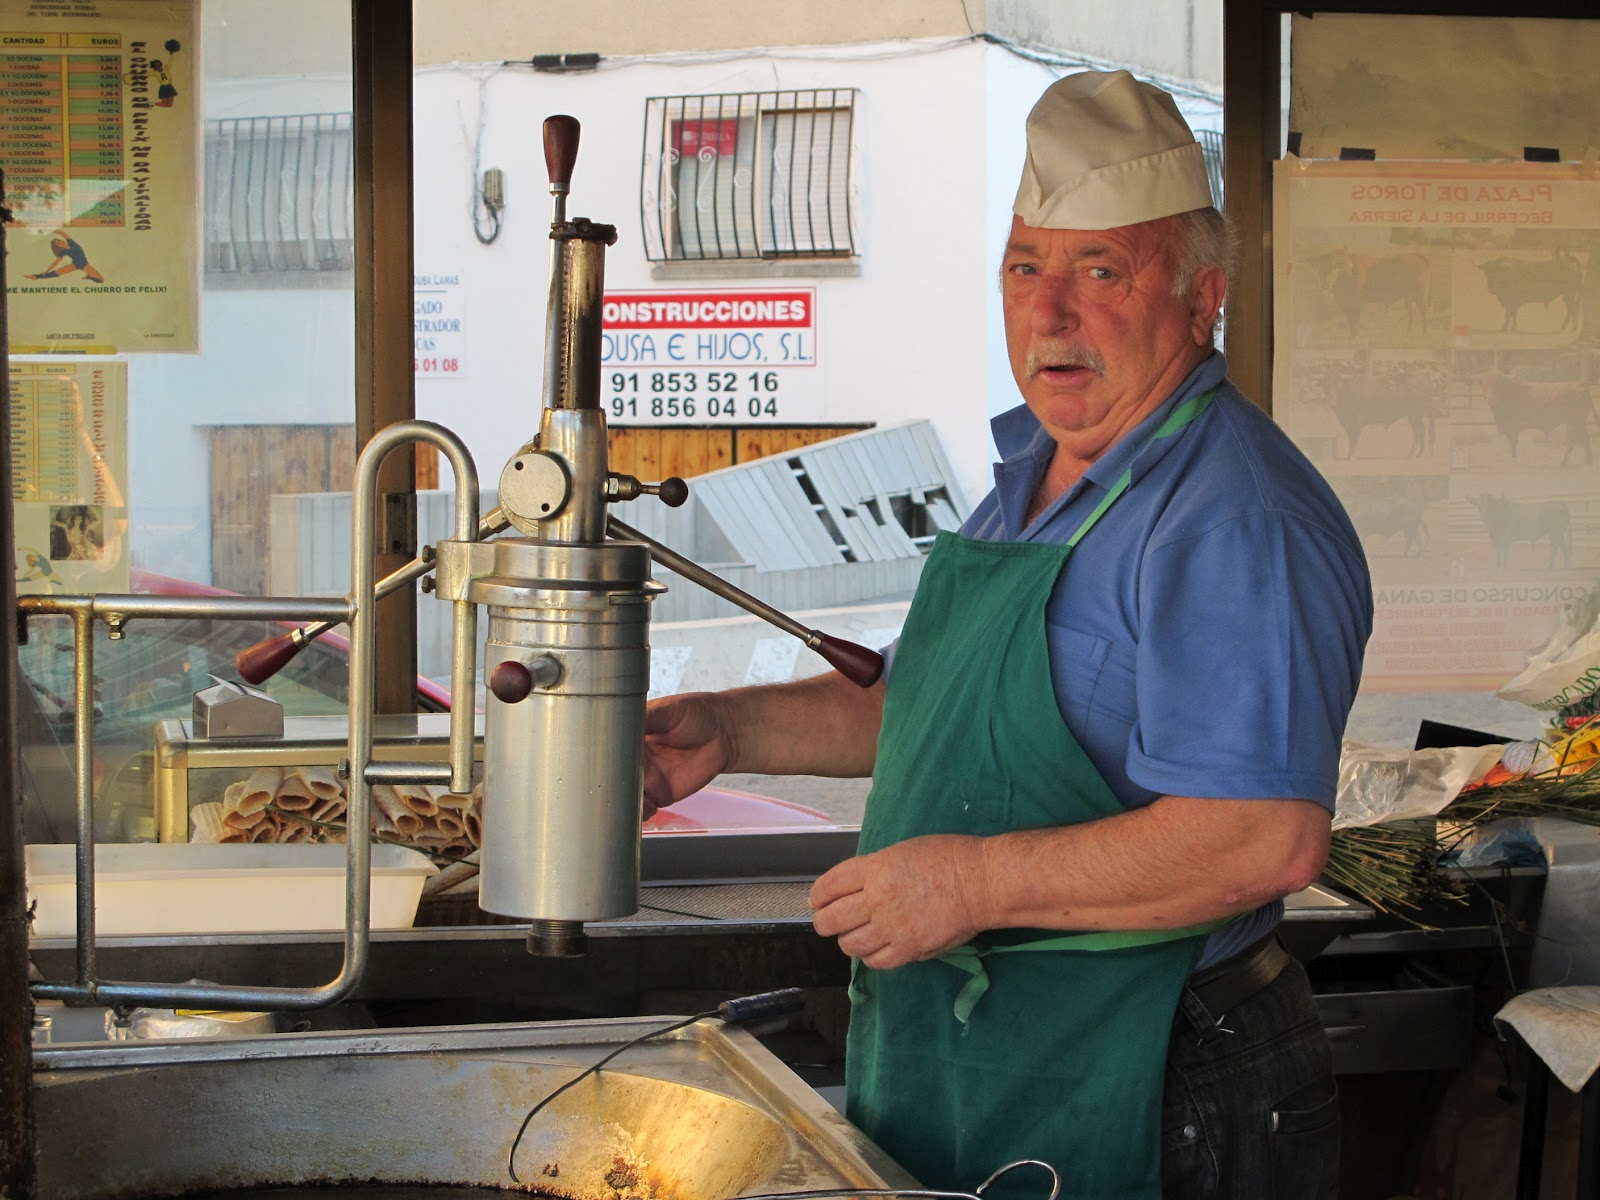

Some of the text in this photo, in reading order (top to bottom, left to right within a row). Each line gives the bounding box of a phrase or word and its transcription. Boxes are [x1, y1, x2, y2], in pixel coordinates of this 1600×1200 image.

[603, 300, 806, 323] ONSTRUCCIONES
[668, 333, 686, 361] E
[698, 332, 768, 362] HIJOS,
[780, 332, 813, 360] S.L.
[423, 358, 437, 372] 01
[443, 358, 458, 372] 08
[612, 372, 778, 392] 91 853 52 16
[612, 397, 778, 417] 91 856 04 04
